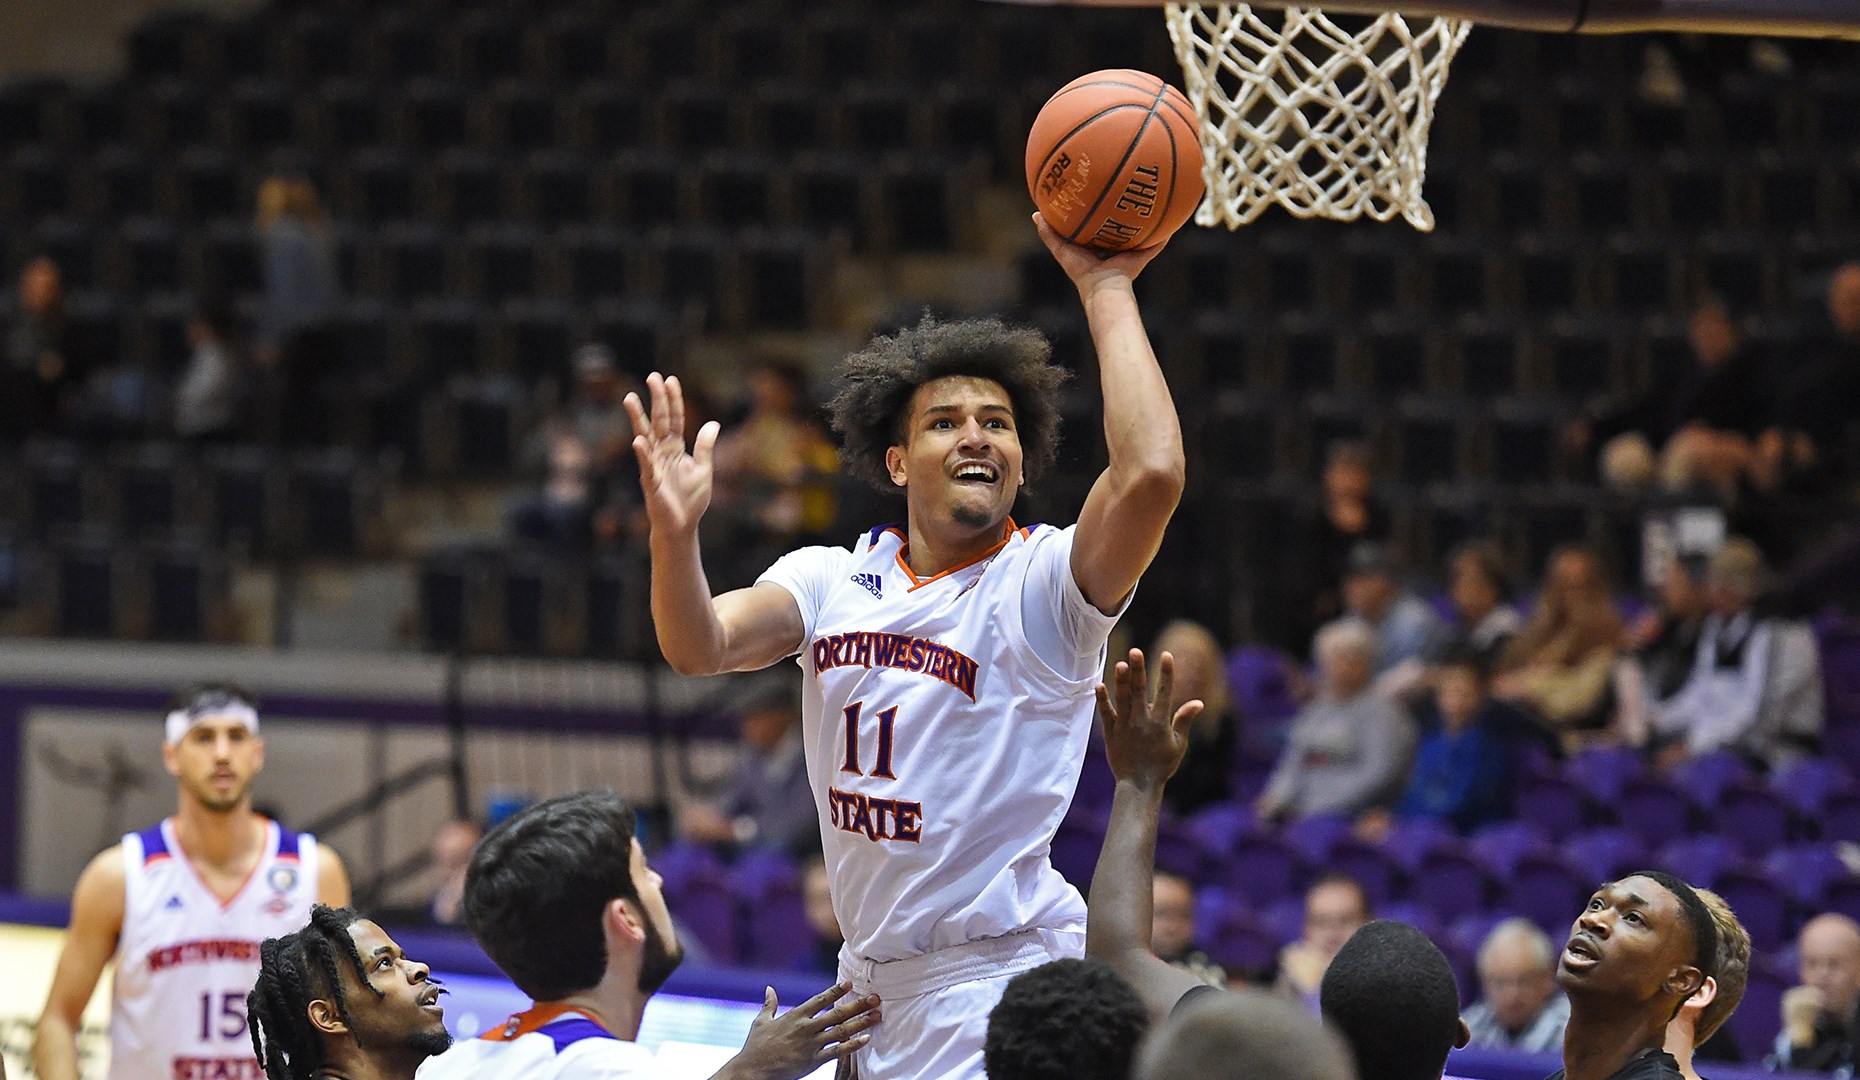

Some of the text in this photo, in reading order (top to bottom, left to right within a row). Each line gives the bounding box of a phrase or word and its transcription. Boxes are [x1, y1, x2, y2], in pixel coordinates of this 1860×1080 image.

[1116, 163, 1159, 217] THE
[850, 574, 884, 600] adidas
[813, 631, 979, 704] ORTHWESTERN
[840, 701, 898, 780] 11
[828, 786, 922, 843] STATE
[199, 993, 249, 1041] 15
